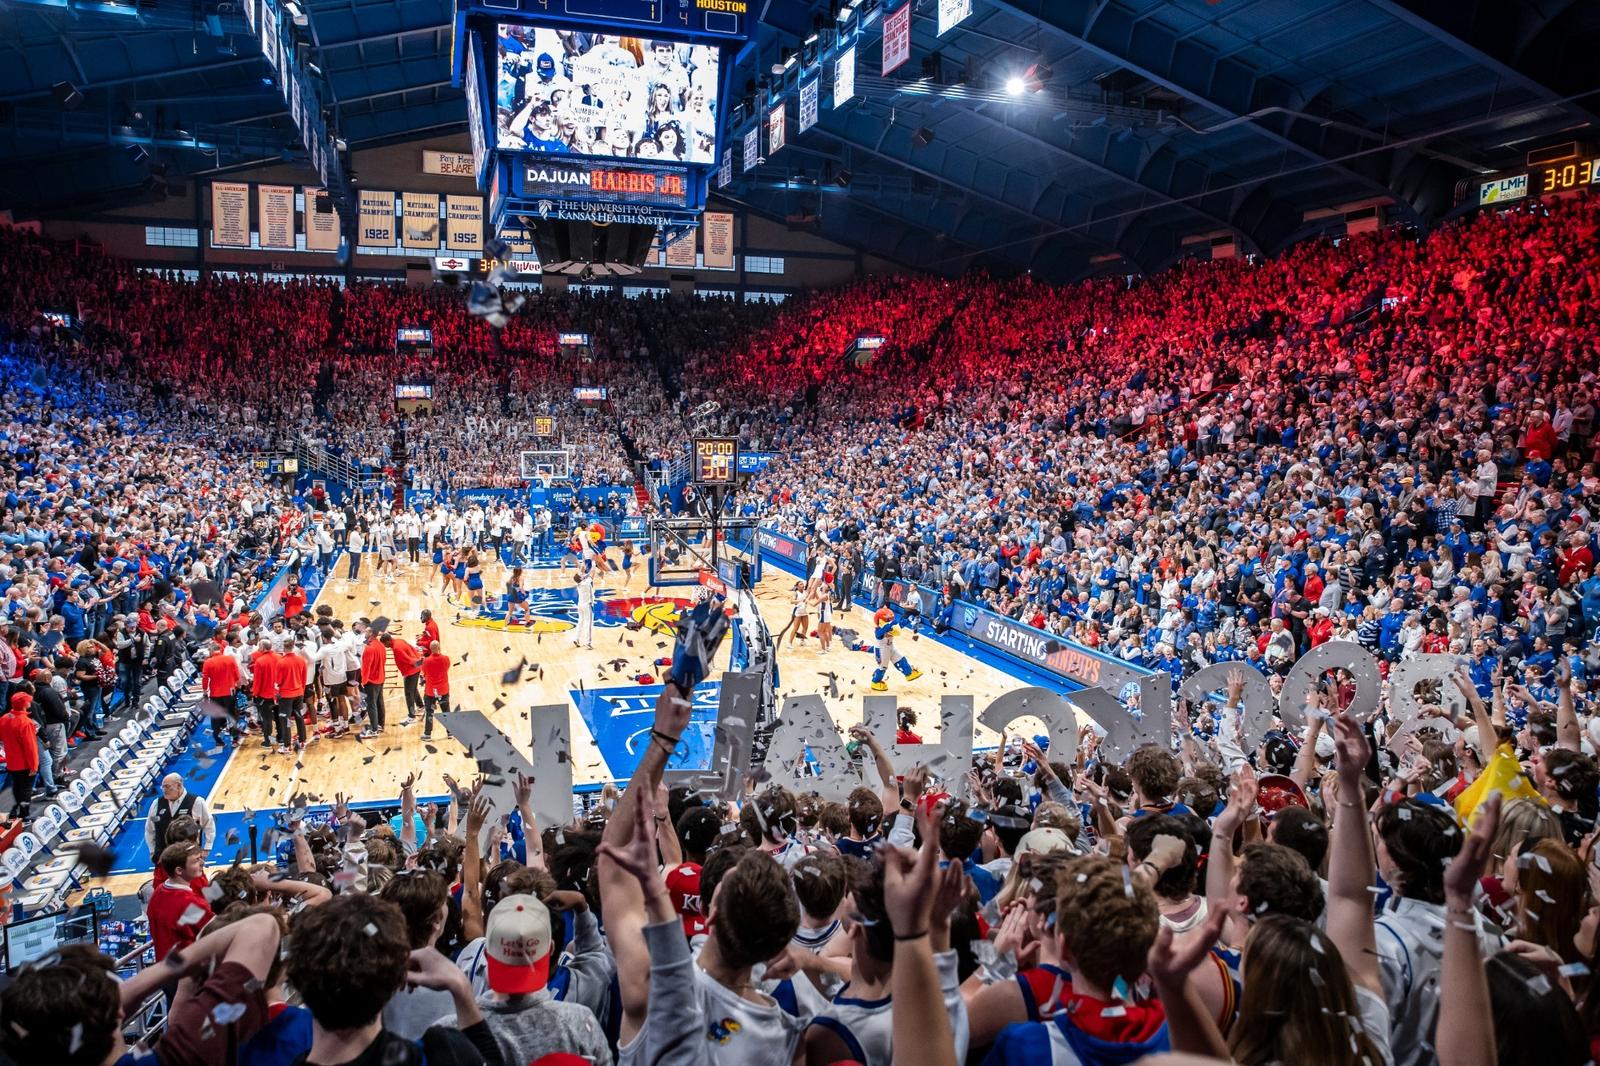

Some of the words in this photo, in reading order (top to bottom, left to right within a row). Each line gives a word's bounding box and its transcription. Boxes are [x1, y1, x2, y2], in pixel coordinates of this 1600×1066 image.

[696, 0, 747, 14] HOUSTON
[679, 12, 688, 26] 4
[440, 163, 473, 175] BEWARE
[526, 169, 591, 186] DAJUAN
[591, 170, 656, 194] HARRIS
[1543, 161, 1592, 191] 3:03
[1500, 176, 1526, 191] LMH
[1499, 187, 1526, 200] Health
[362, 199, 391, 207] NATIONAL
[407, 201, 436, 209] NATIONAL
[451, 204, 480, 212] NATIONAL
[557, 199, 579, 211] THE
[580, 201, 639, 215] UNIVERSITY
[640, 205, 654, 215] OF
[360, 208, 394, 216] CHAMPIONS
[404, 210, 439, 218] CHAMPIONS
[558, 210, 596, 221] KANSAS
[598, 212, 635, 224] HEALTH
[636, 214, 672, 226] SYSTEM
[365, 228, 389, 240] 1922
[453, 233, 477, 244] 1952
[698, 443, 733, 455] 20:00
[702, 456, 728, 479] 30
[986, 621, 1048, 661] STARTING
[500, 937, 524, 948] Let's
[526, 937, 540, 947] Go
